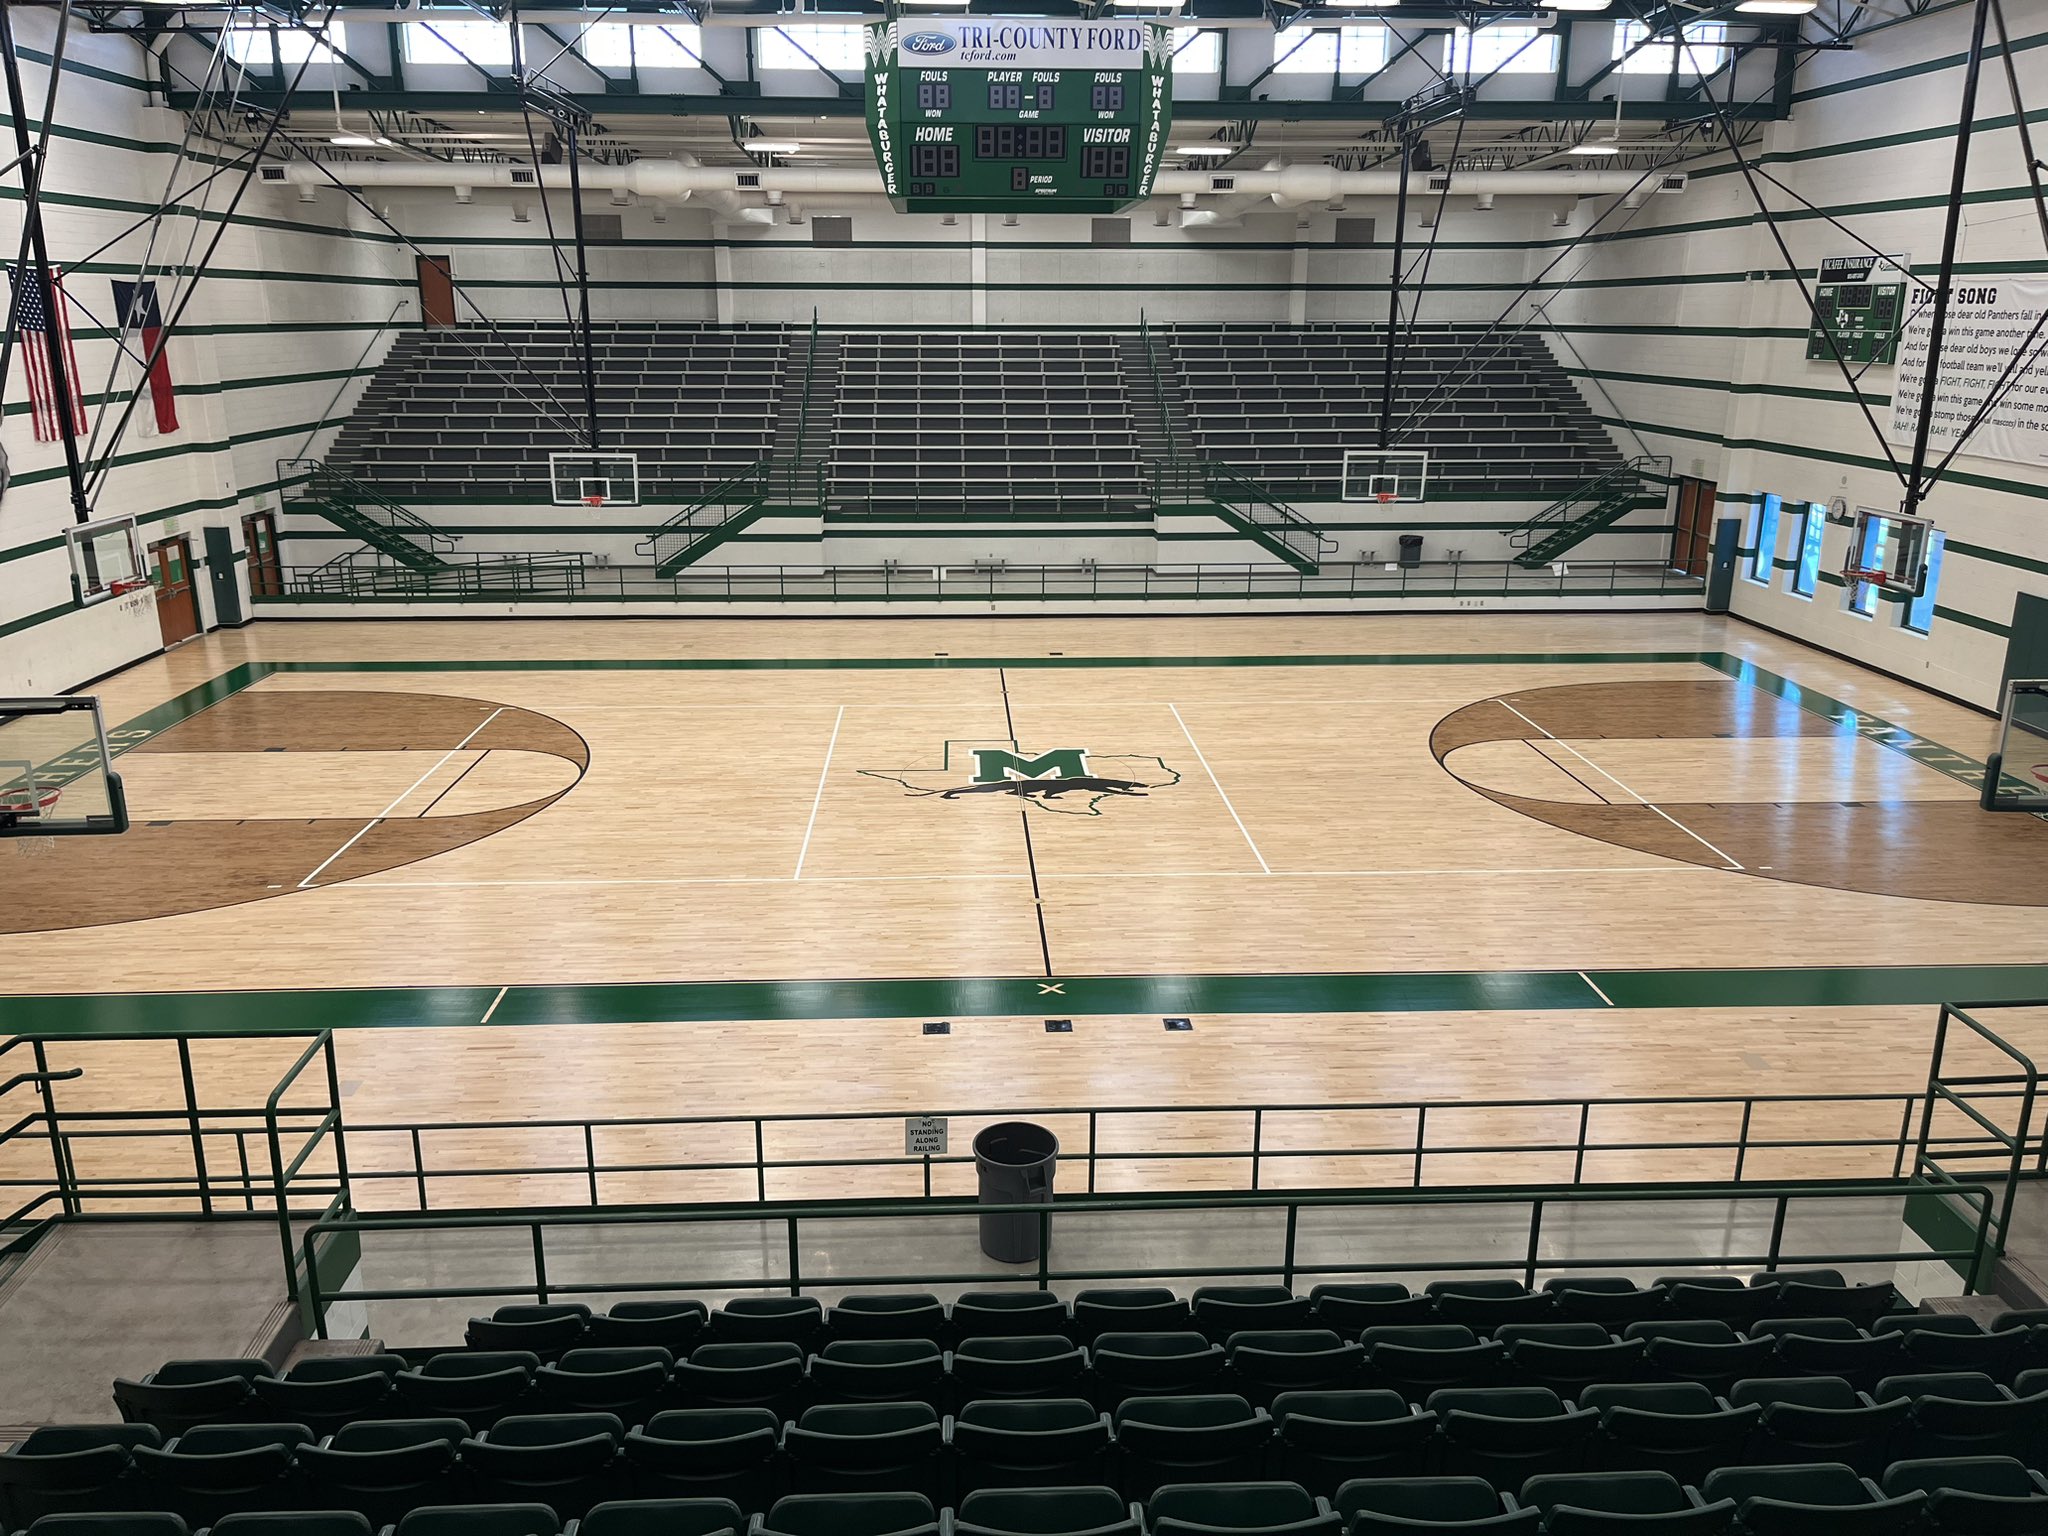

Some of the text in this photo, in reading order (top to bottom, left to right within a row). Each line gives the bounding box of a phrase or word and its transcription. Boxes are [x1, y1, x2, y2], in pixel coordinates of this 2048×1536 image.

[911, 36, 945, 52] Ford
[958, 26, 1141, 51] TRI-COUNTY FORD
[960, 50, 1017, 62] tcford.com
[920, 71, 948, 82] FOULS
[987, 71, 1060, 83] PLAYER FOULS
[1094, 72, 1122, 83] FOULS
[925, 109, 941, 118] WON
[1019, 110, 1039, 119] GAME
[1098, 110, 1115, 119] WON
[874, 72, 897, 194] WHATABURGER
[915, 126, 953, 142] HOME
[1083, 128, 1131, 143] VISITOR
[1139, 75, 1164, 196] WHATABURGER
[1029, 175, 1053, 184] PERIOD
[1819, 287, 1834, 297] HOME
[1957, 287, 1997, 305] SONG
[1957, 309, 1973, 320] dear
[1974, 309, 1986, 320] old
[1987, 309, 2019, 320] Panthers
[2021, 309, 2033, 321] fall
[1908, 325, 1926, 335] We're
[1949, 326, 1960, 336] win
[1961, 326, 1974, 337] this
[1974, 329, 1995, 340] game
[1996, 327, 2026, 338] another
[1904, 341, 1918, 351] And
[1919, 341, 1929, 351] for
[1950, 342, 1966, 353] dear
[1966, 344, 1979, 354] old
[1979, 344, 1997, 357] boys
[1999, 347, 2010, 355] we
[2010, 345, 2027, 356] loe
[1901, 357, 1915, 367] And
[1916, 357, 1926, 368] for
[1940, 358, 1966, 370] football
[1966, 361, 1985, 372] team
[1900, 373, 1918, 384] We're
[1940, 376, 1962, 388] FIGHT,
[1962, 378, 1986, 390] FIGHT,
[2024, 384, 2039, 394] our
[1938, 392, 1949, 402] win
[1950, 393, 1962, 404] this
[1963, 396, 1983, 407] game
[2000, 398, 2012, 409] win
[2013, 401, 2034, 412] some
[1934, 410, 1955, 422] stomp
[2017, 417, 2025, 429] in
[2026, 418, 2039, 431] the
[1929, 424, 1948, 435] RAH!
